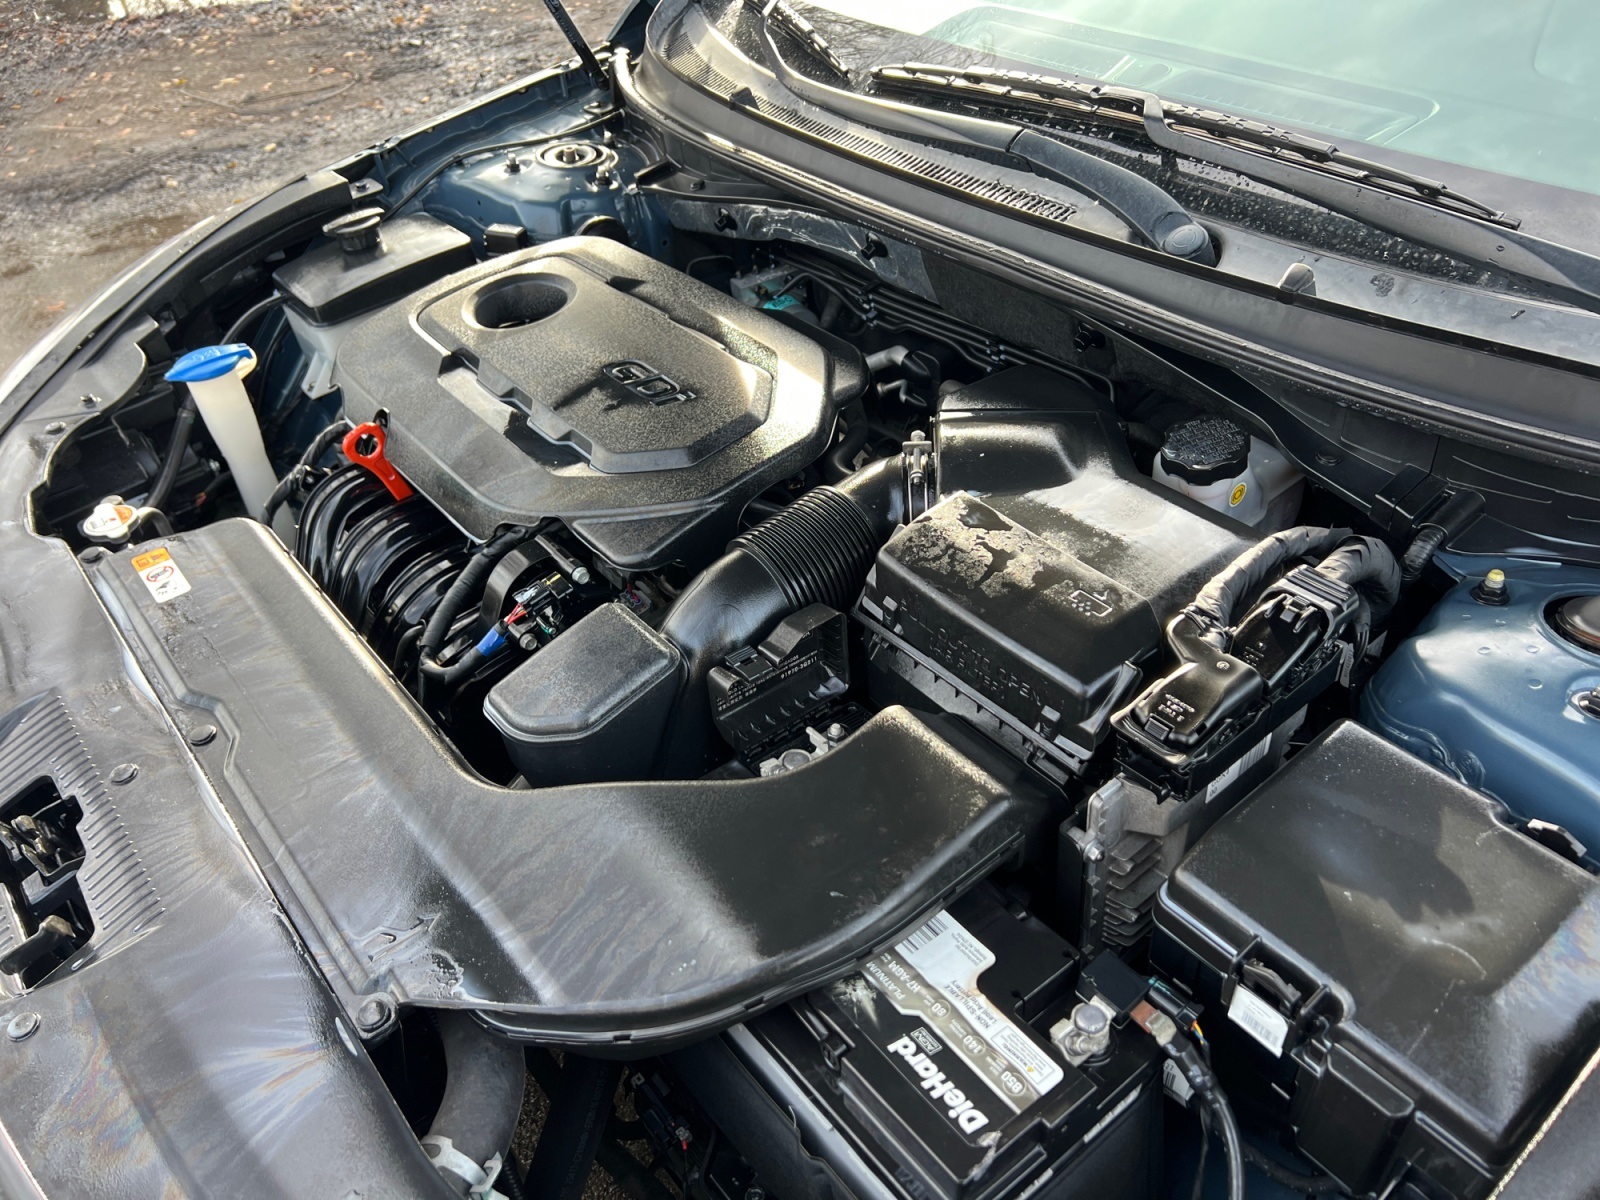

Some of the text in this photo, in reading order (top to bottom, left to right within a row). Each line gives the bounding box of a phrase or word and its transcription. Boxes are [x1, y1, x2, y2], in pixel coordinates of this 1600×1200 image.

[998, 668, 1042, 706] OPEN
[865, 961, 906, 1000] PLATINUM
[888, 960, 920, 993] H7-AGM
[943, 984, 990, 1030] NON-SPILLABLE
[983, 1008, 997, 1025] Lead
[963, 1035, 981, 1054] 140
[886, 1036, 990, 1135] DieHard
[1001, 1070, 1022, 1093] 850
